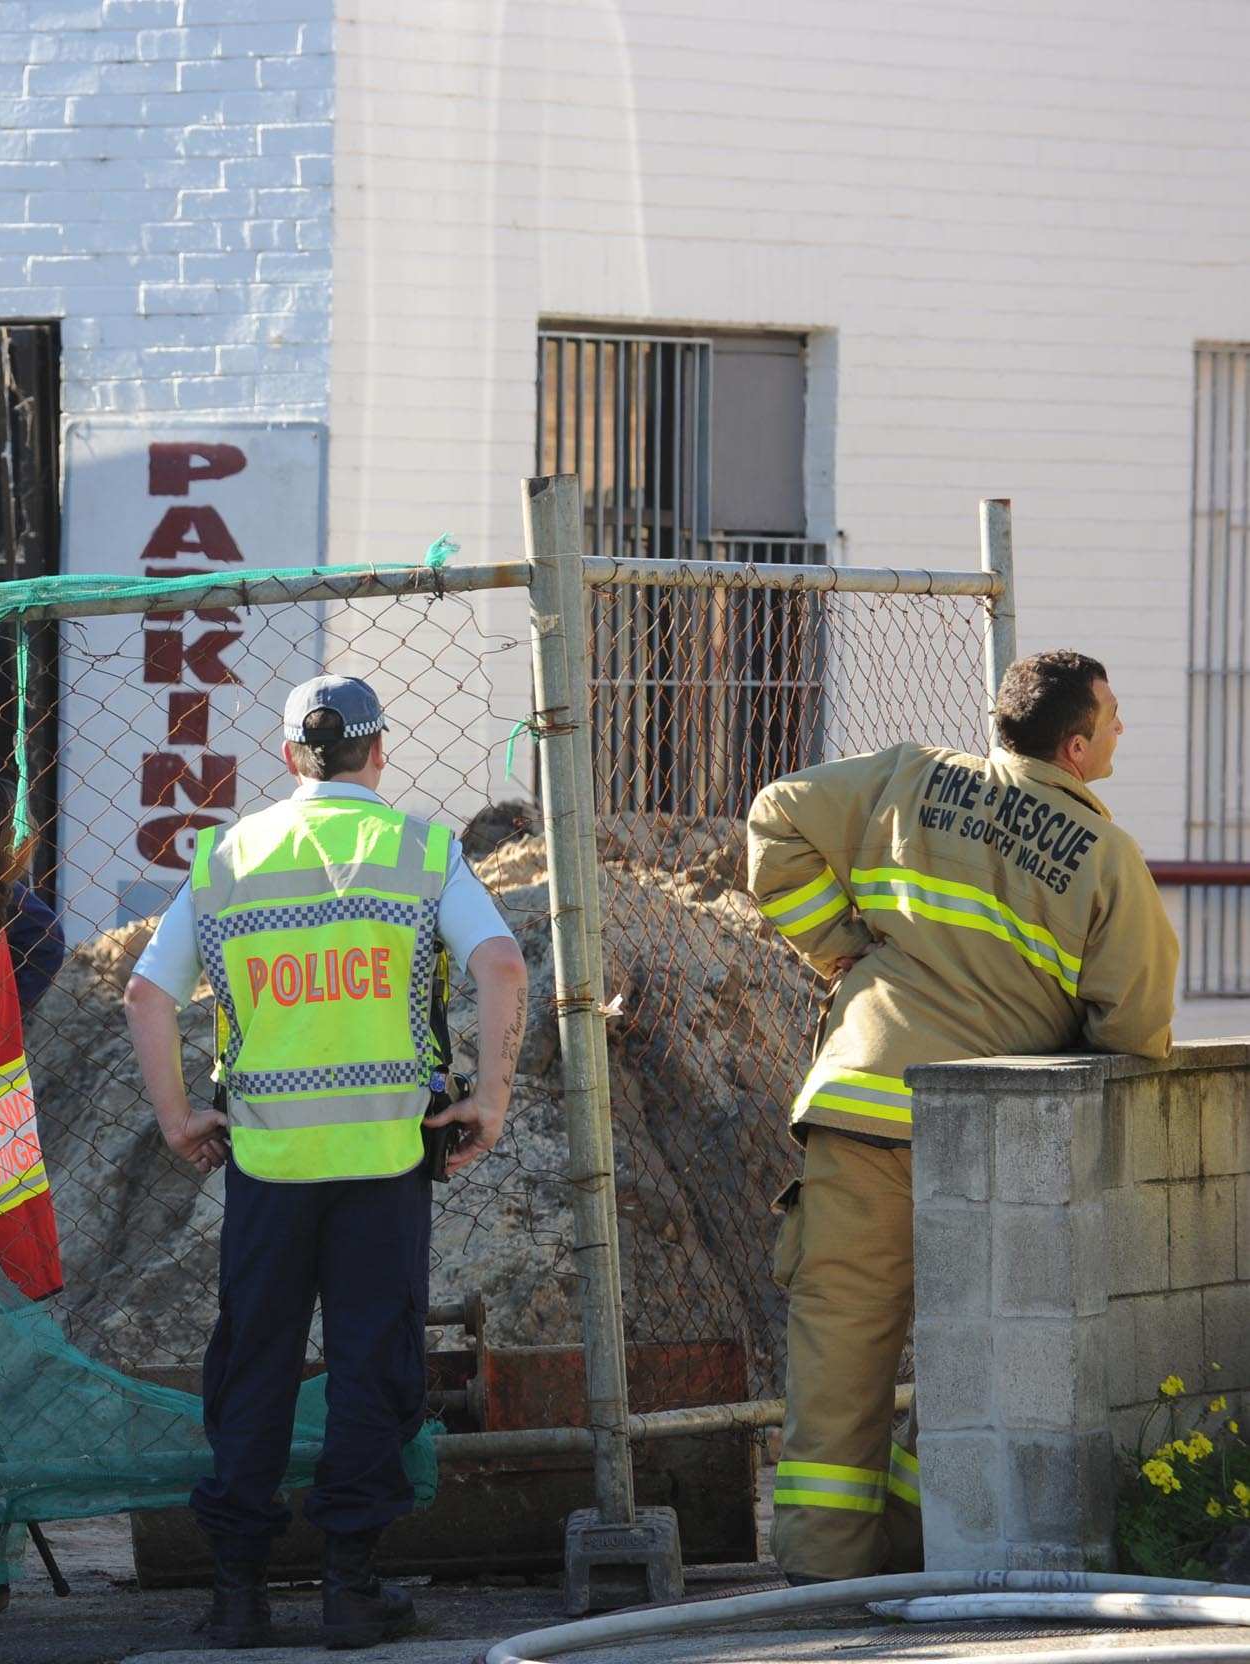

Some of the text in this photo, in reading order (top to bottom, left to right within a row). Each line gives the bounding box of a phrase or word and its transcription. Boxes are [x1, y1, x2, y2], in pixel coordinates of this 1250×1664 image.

[919, 805, 1071, 895] NEW SOUTH WALES
[924, 762, 1098, 872] FIRE & RESCUE
[246, 947, 392, 1009] POLICE
